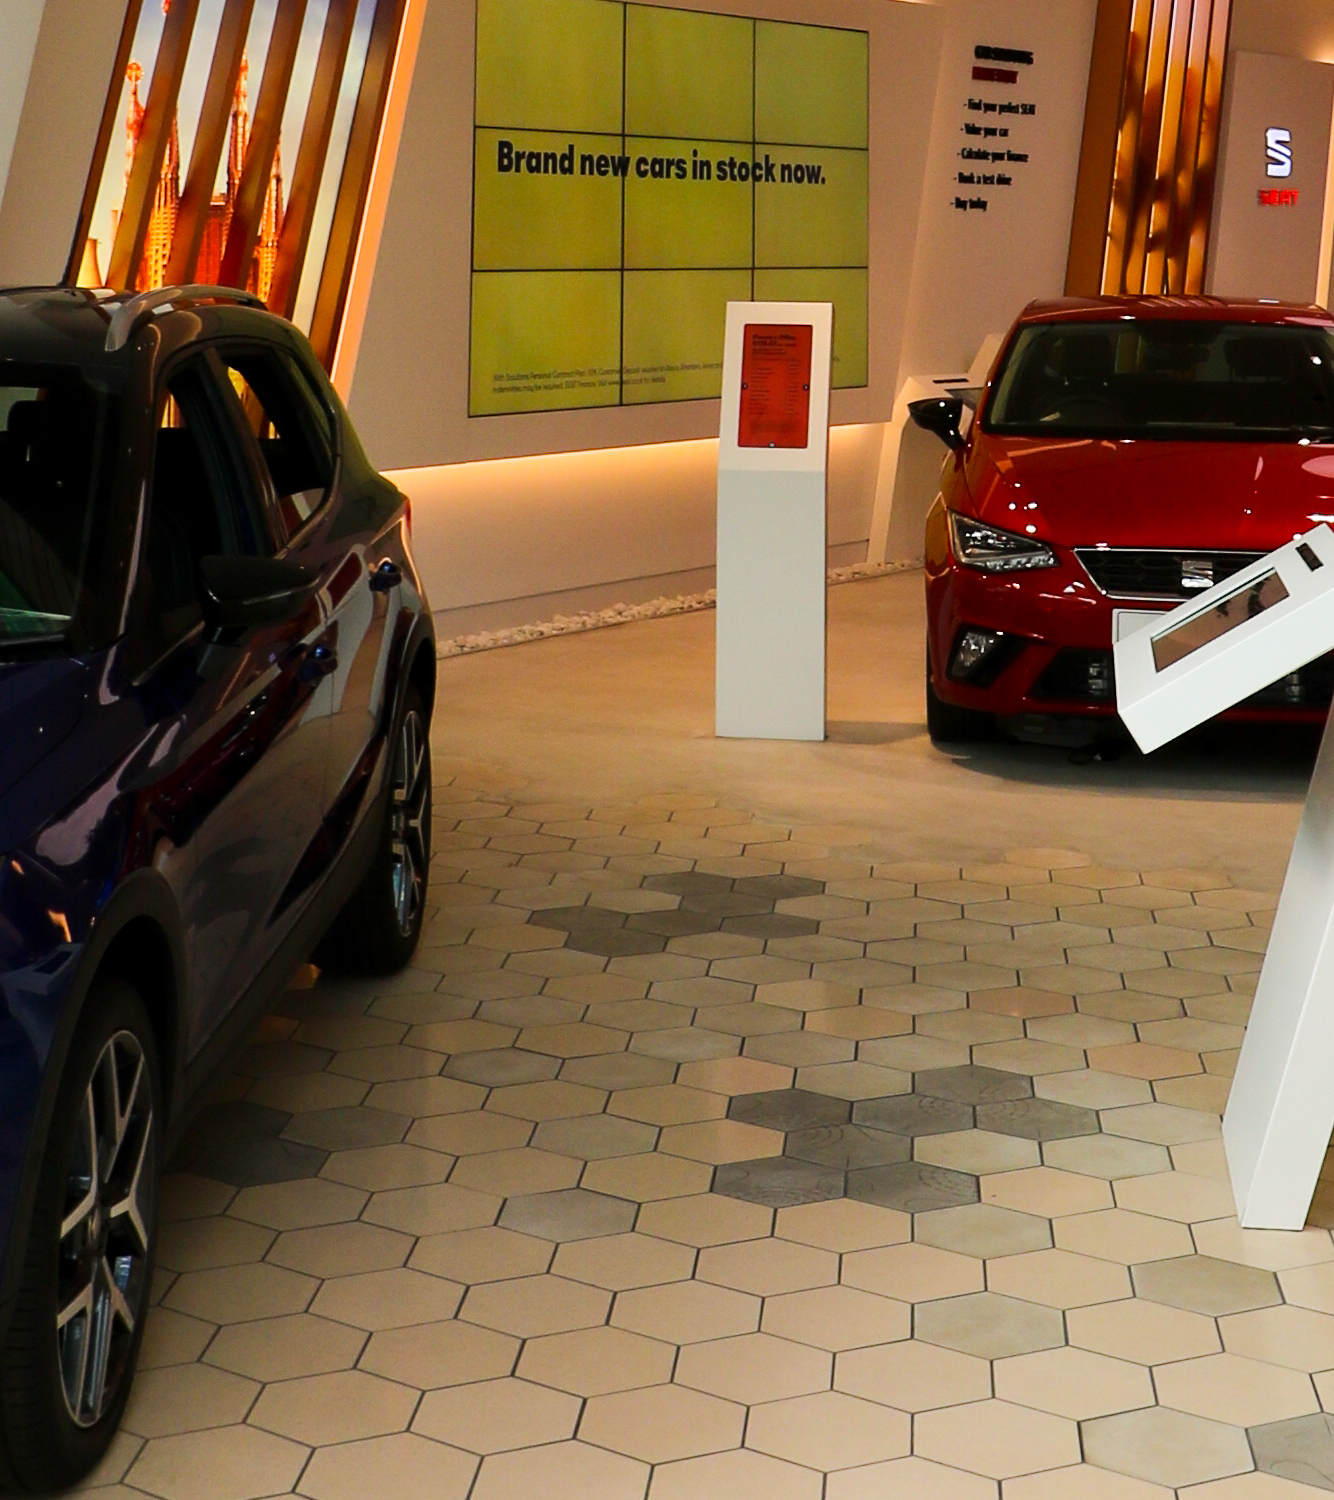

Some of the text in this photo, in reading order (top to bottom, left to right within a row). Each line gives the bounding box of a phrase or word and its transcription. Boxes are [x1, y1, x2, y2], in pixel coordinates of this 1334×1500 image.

[497, 140, 826, 185] Brand new cars in stock now.
[1258, 187, 1299, 206] SEAT
